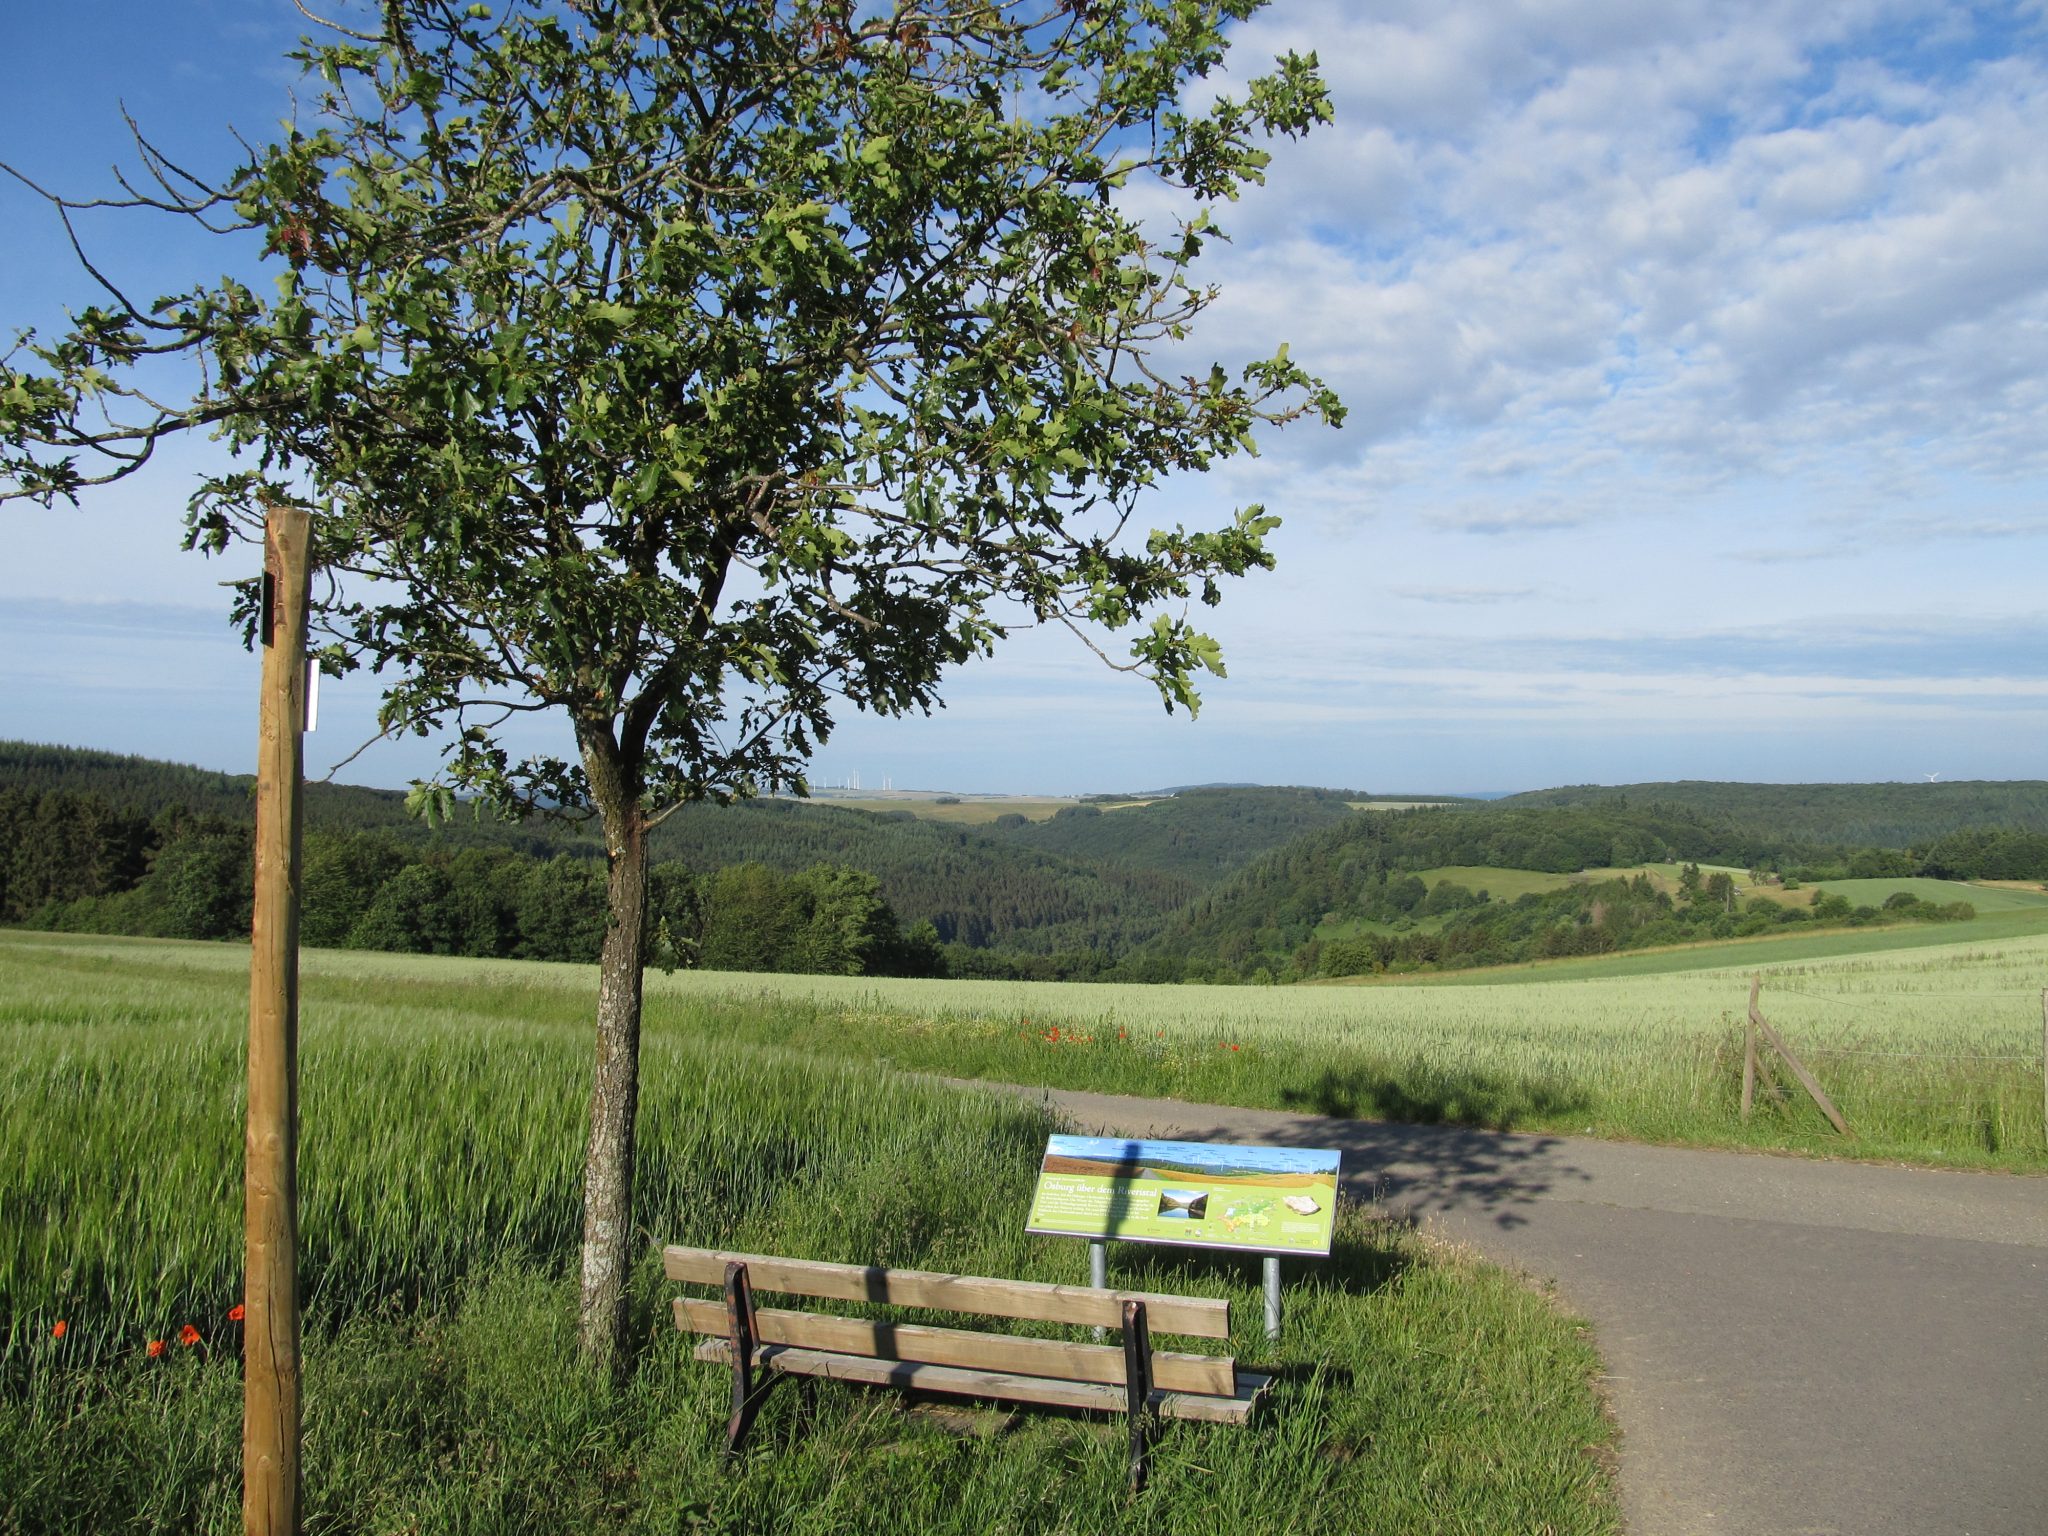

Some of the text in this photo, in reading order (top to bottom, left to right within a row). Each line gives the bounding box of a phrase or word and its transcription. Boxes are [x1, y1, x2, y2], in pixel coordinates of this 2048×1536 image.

[1043, 1181, 1075, 1193] Osburg
[1077, 1183, 1096, 1193] über
[1098, 1184, 1115, 1194] dem
